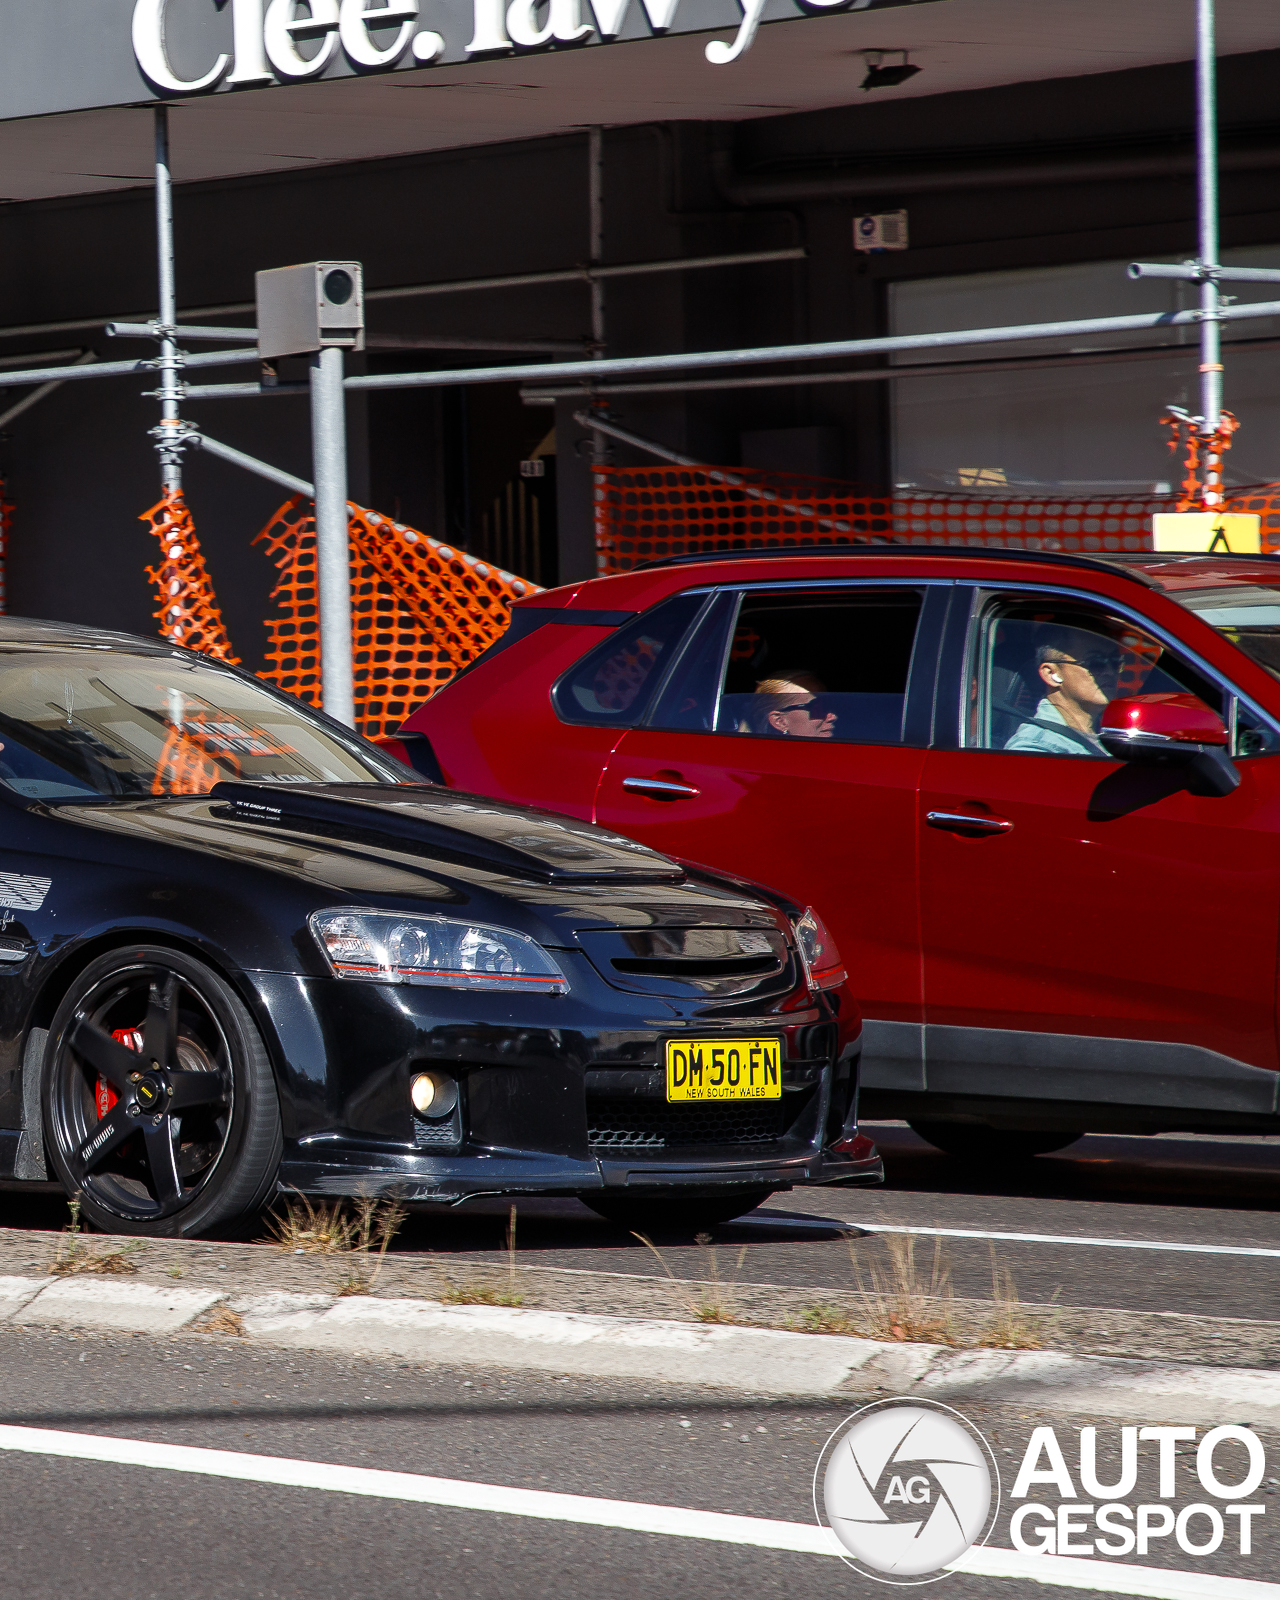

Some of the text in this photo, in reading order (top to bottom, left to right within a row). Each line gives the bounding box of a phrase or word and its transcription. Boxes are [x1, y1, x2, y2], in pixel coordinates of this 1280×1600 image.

[132, 0, 445, 91] Clee.
[686, 1086, 766, 1099] NEW SOUTH WALES
